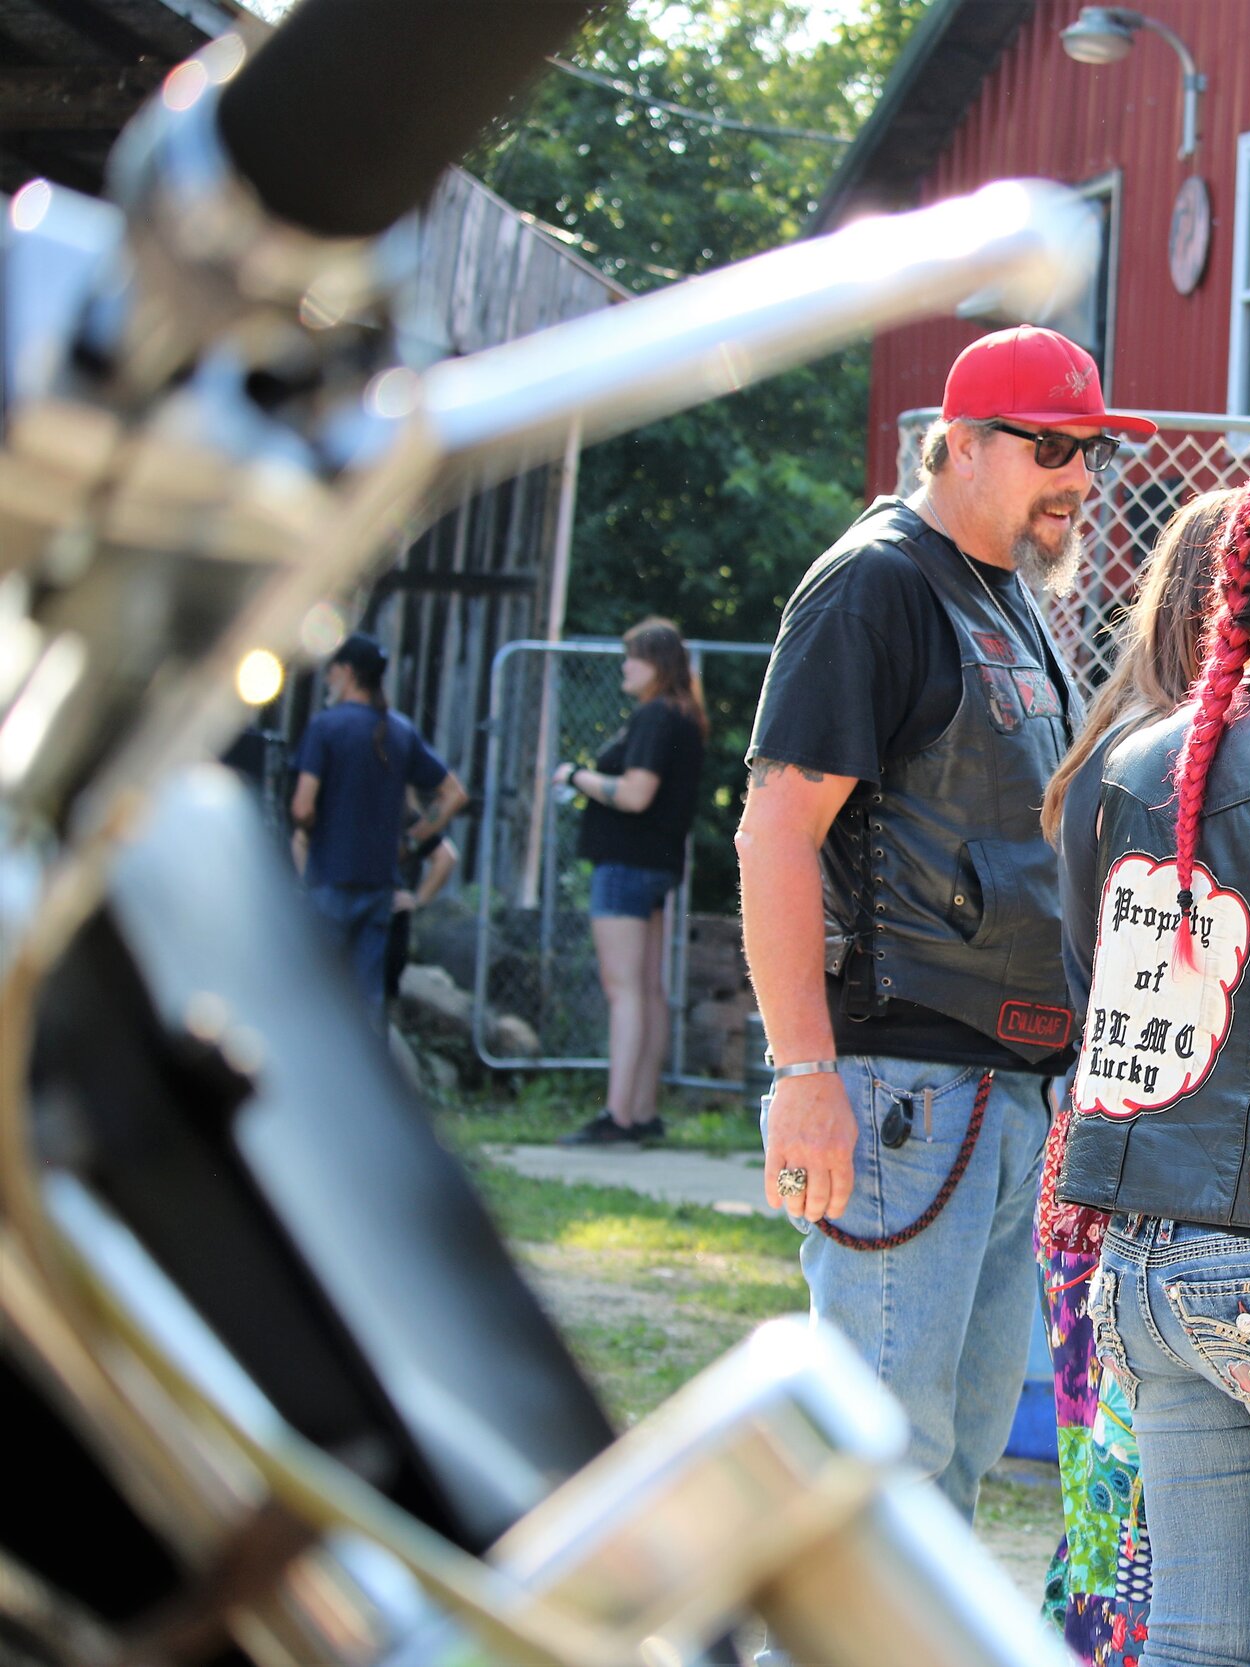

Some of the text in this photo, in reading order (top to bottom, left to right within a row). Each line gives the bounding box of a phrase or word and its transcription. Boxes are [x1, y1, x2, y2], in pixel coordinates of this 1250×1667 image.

[1113, 886, 1213, 948] Propety
[1134, 961, 1168, 993] of
[1089, 1047, 1160, 1093] Lucky
